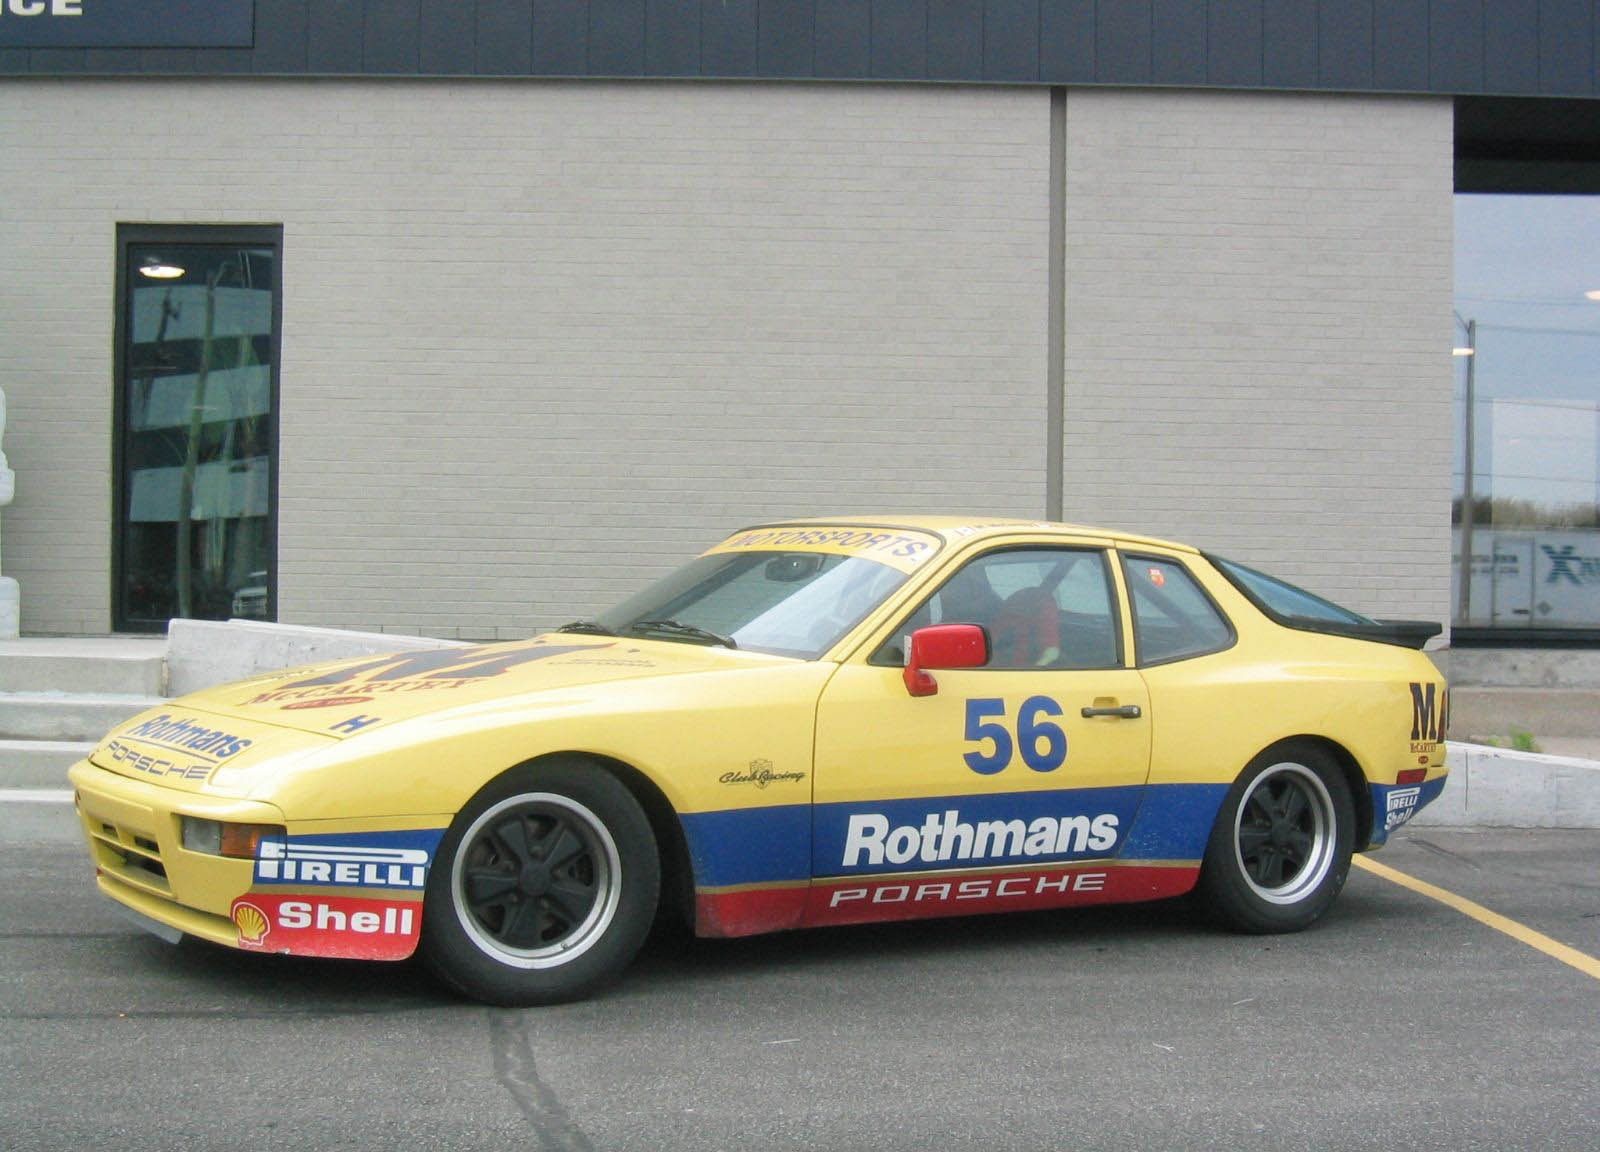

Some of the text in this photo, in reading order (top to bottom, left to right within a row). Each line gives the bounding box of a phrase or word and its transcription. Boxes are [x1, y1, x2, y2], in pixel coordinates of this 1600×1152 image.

[0, 0, 83, 16] CE
[126, 714, 252, 758] Rothmans
[963, 695, 1067, 775] 56
[106, 741, 212, 780] PORSCHE
[1386, 787, 1420, 812] PIRELLI
[1384, 806, 1413, 831] Shell
[842, 810, 1119, 867] Rothmans
[258, 840, 428, 887] PIRELLI
[829, 873, 1107, 907] PORSCHE
[278, 901, 413, 935] Shell
